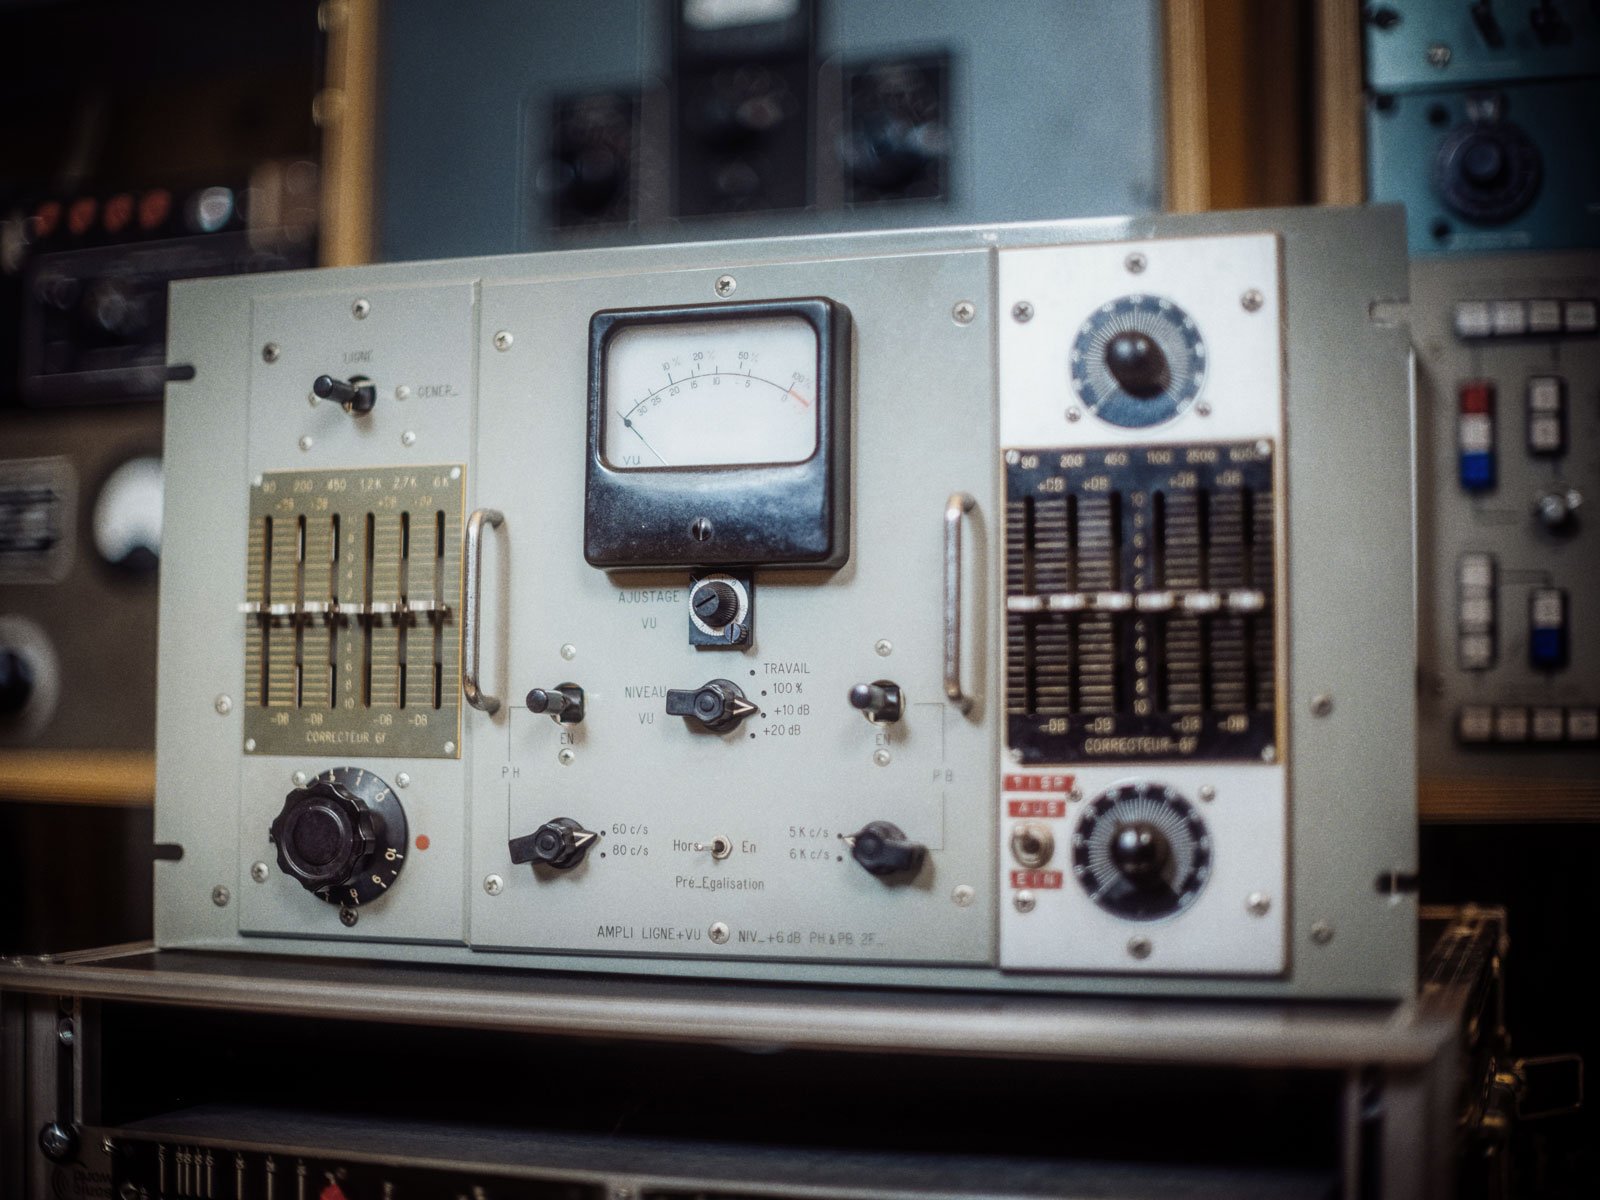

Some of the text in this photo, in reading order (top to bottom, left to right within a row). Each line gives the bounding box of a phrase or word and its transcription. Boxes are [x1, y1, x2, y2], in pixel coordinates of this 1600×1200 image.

[692, 352, 704, 361] 20
[738, 352, 749, 360] 50
[662, 362, 670, 372] 10
[690, 381, 698, 390] 15
[712, 378, 720, 386] 10
[744, 380, 750, 388] 5
[669, 386, 680, 396] 20
[650, 396, 662, 406] 25
[636, 404, 648, 417] 30
[622, 454, 642, 466] VU
[618, 590, 680, 604] AJUSTAGE
[642, 616, 657, 630] VU
[764, 662, 810, 674] TRAVAIL
[624, 686, 668, 698] NIVEAU
[773, 683, 803, 694] 100 %
[774, 704, 810, 716] +10 dB
[638, 712, 654, 724] VU
[763, 724, 801, 736] +20 dB
[560, 732, 574, 745] EN
[876, 734, 890, 746] EN
[612, 824, 648, 836] 60 c/s
[789, 826, 828, 838] 5 K c/s
[612, 844, 649, 857] 80 c/s
[674, 840, 699, 852] Hors
[742, 840, 757, 853] En
[790, 848, 830, 860] 6 K c/s
[597, 925, 634, 939] AMPLI
